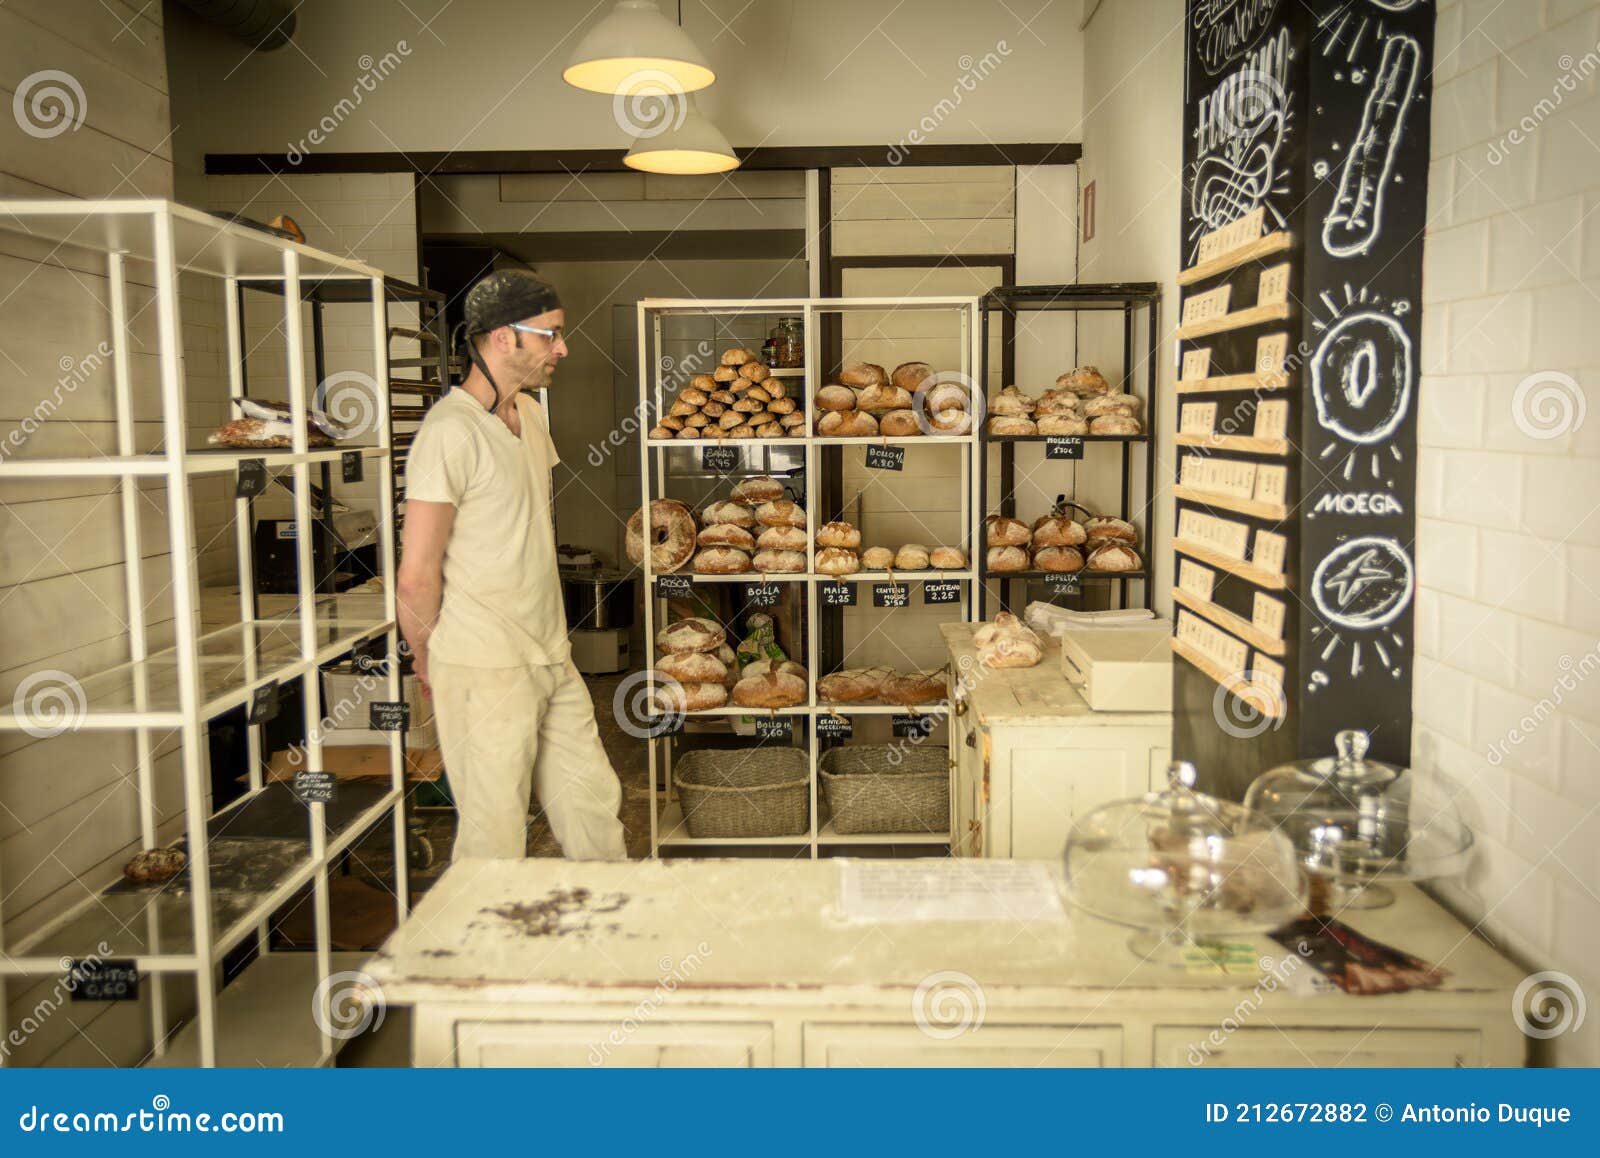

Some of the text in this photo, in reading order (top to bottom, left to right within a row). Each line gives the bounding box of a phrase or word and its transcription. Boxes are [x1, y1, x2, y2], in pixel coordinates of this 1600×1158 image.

[1313, 493, 1403, 514] MOEGA
[660, 578, 690, 588] ROSCA
[925, 584, 960, 592] CENTENO
[747, 586, 780, 596] BOLLA
